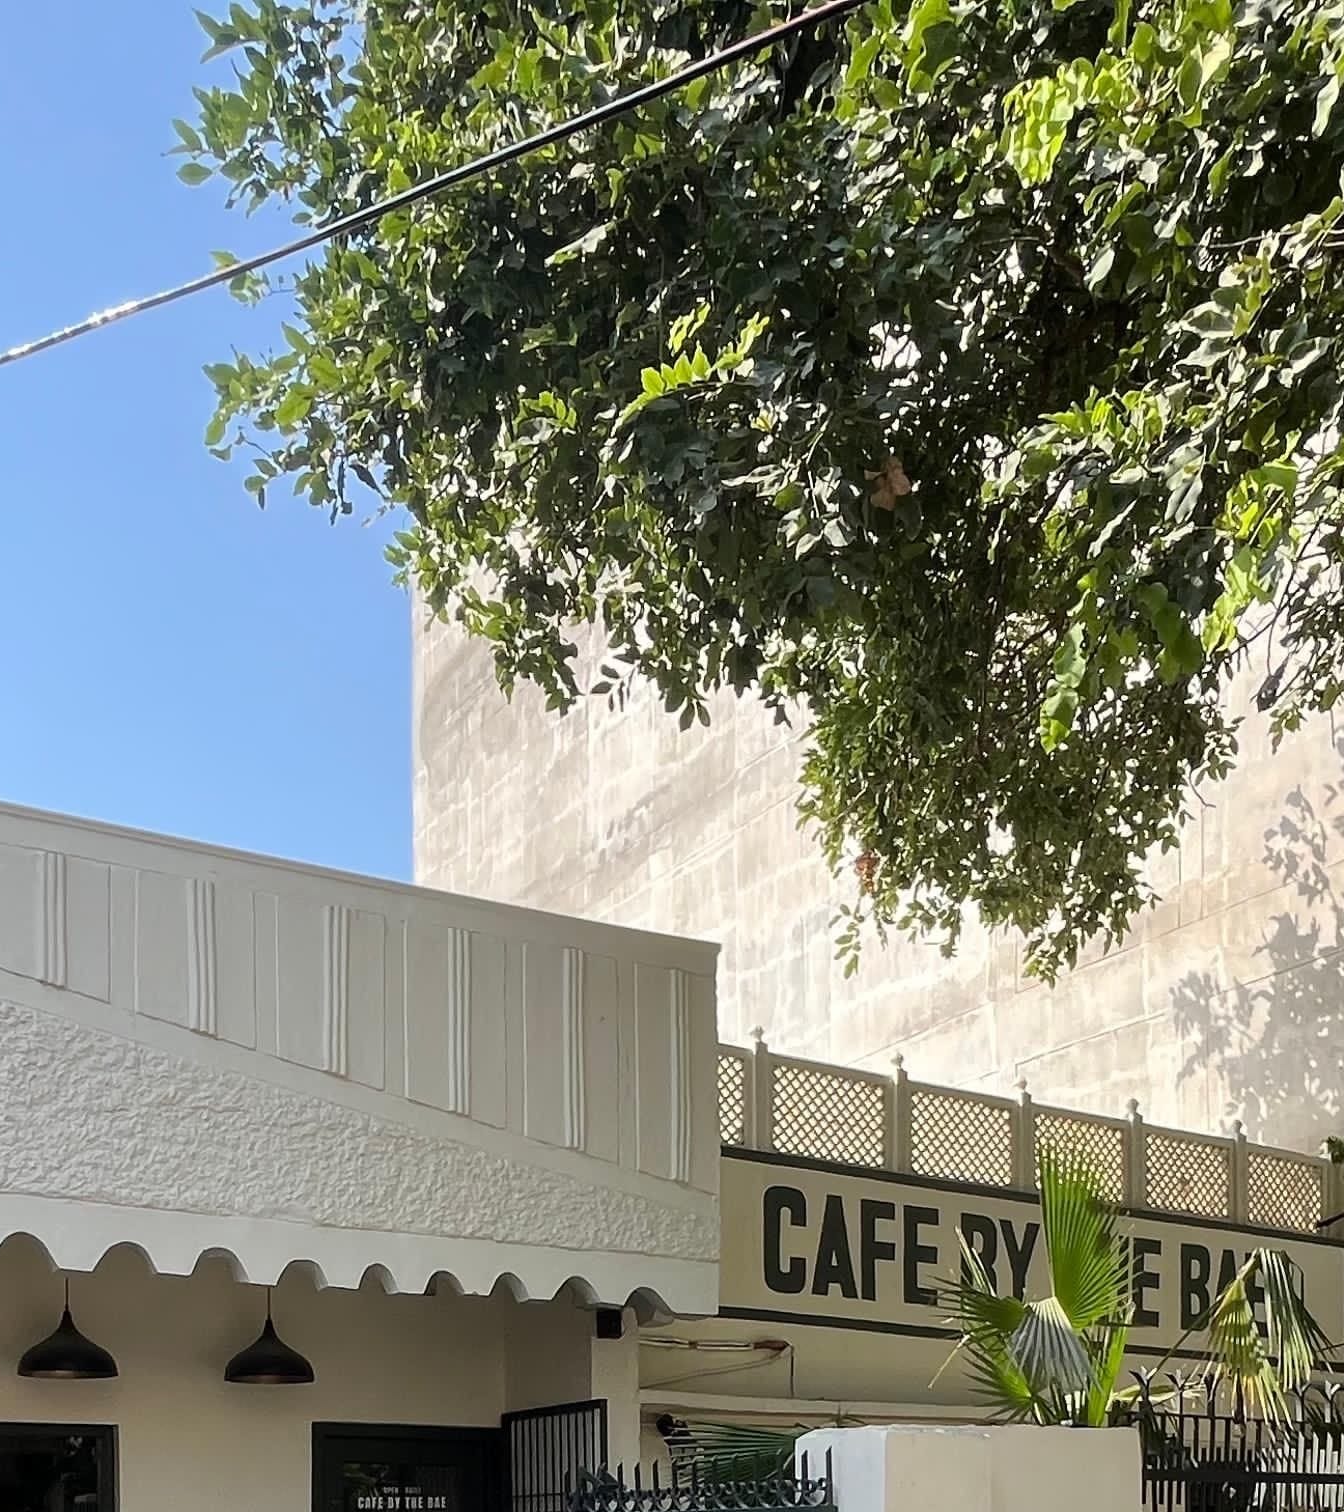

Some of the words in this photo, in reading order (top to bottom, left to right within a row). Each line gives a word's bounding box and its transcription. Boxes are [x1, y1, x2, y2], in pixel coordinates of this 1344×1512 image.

[762, 1185, 940, 1306] CAFE
[960, 1212, 1041, 1303] BY
[357, 1496, 384, 1509] CAFE
[405, 1496, 424, 1509] THE
